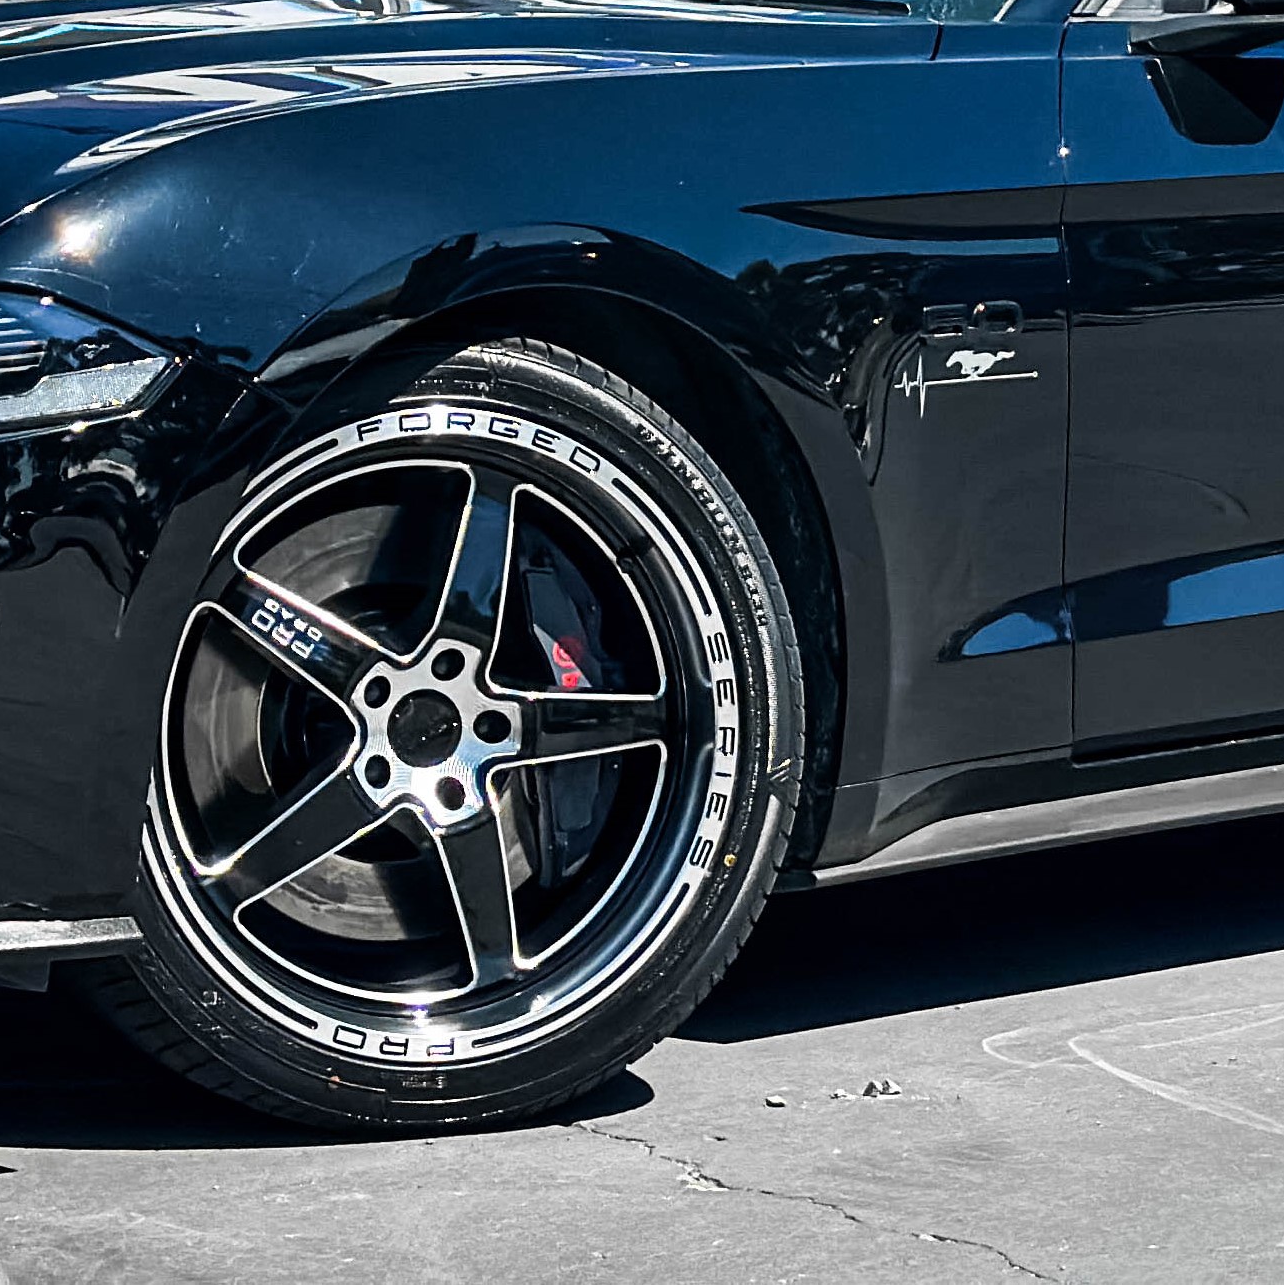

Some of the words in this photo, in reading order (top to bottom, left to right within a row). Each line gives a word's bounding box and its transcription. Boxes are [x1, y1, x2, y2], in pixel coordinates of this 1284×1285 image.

[355, 411, 601, 477] FORGED
[251, 608, 315, 659] PRO
[685, 630, 737, 870] SERIES
[332, 1024, 455, 1057] PRO
